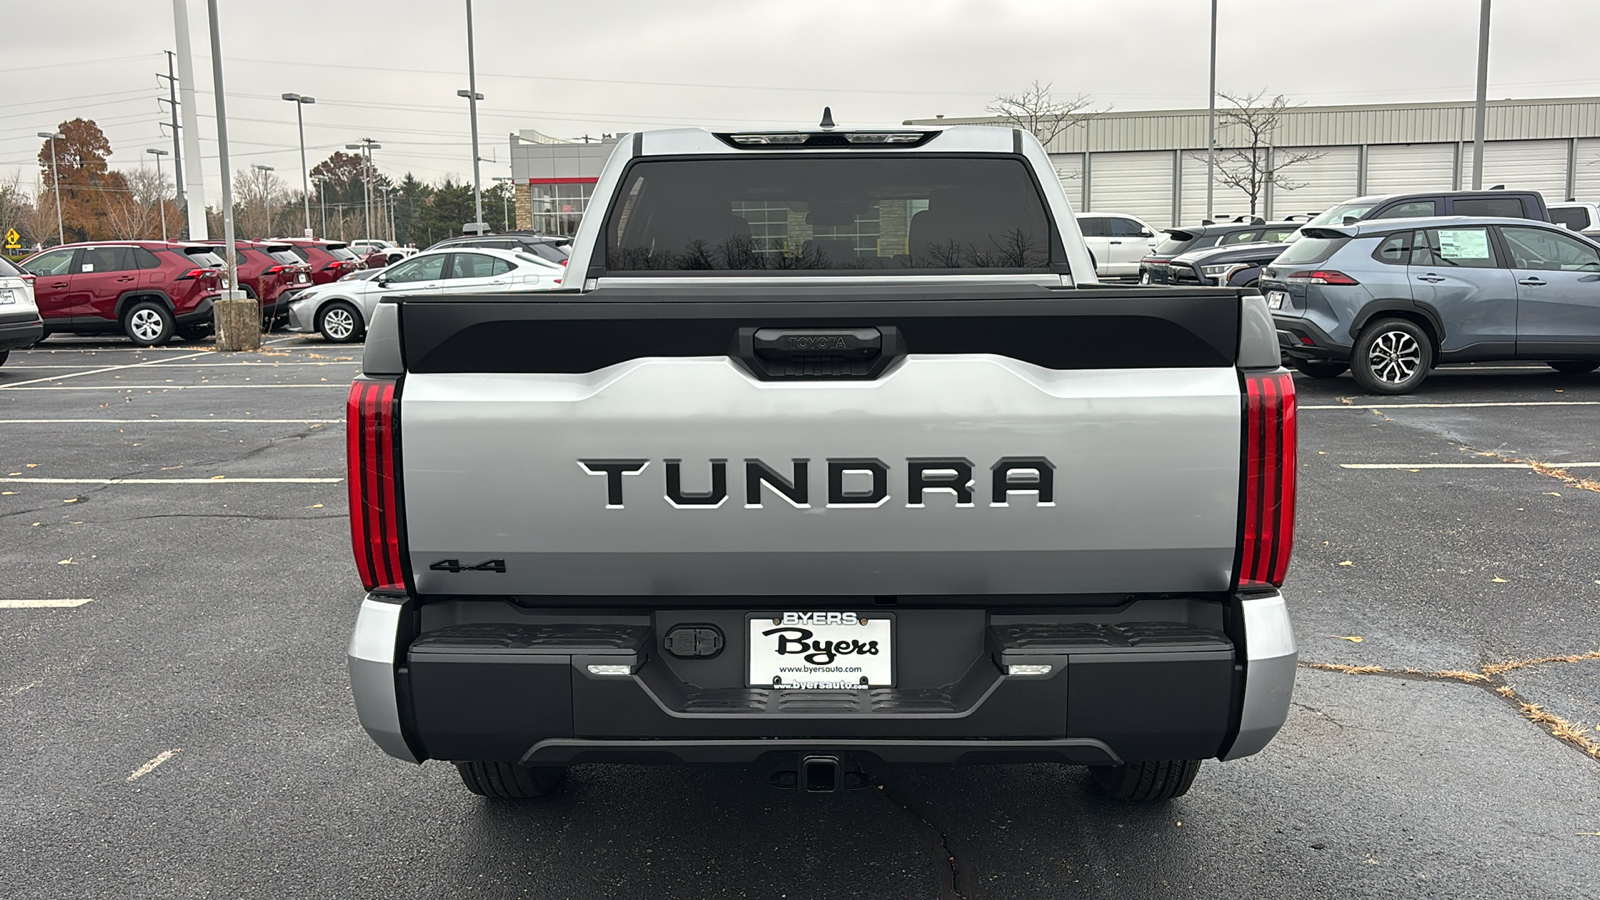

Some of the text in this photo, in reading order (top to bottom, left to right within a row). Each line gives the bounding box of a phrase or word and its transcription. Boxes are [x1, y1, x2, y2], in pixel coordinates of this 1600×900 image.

[788, 337, 847, 349] TOYOTA
[577, 456, 1058, 509] TUNDRA
[783, 612, 857, 625] BYERS
[761, 627, 879, 665] Byers
[779, 665, 862, 674] www.byersauto.com
[773, 680, 869, 690] www.byersauto.com
